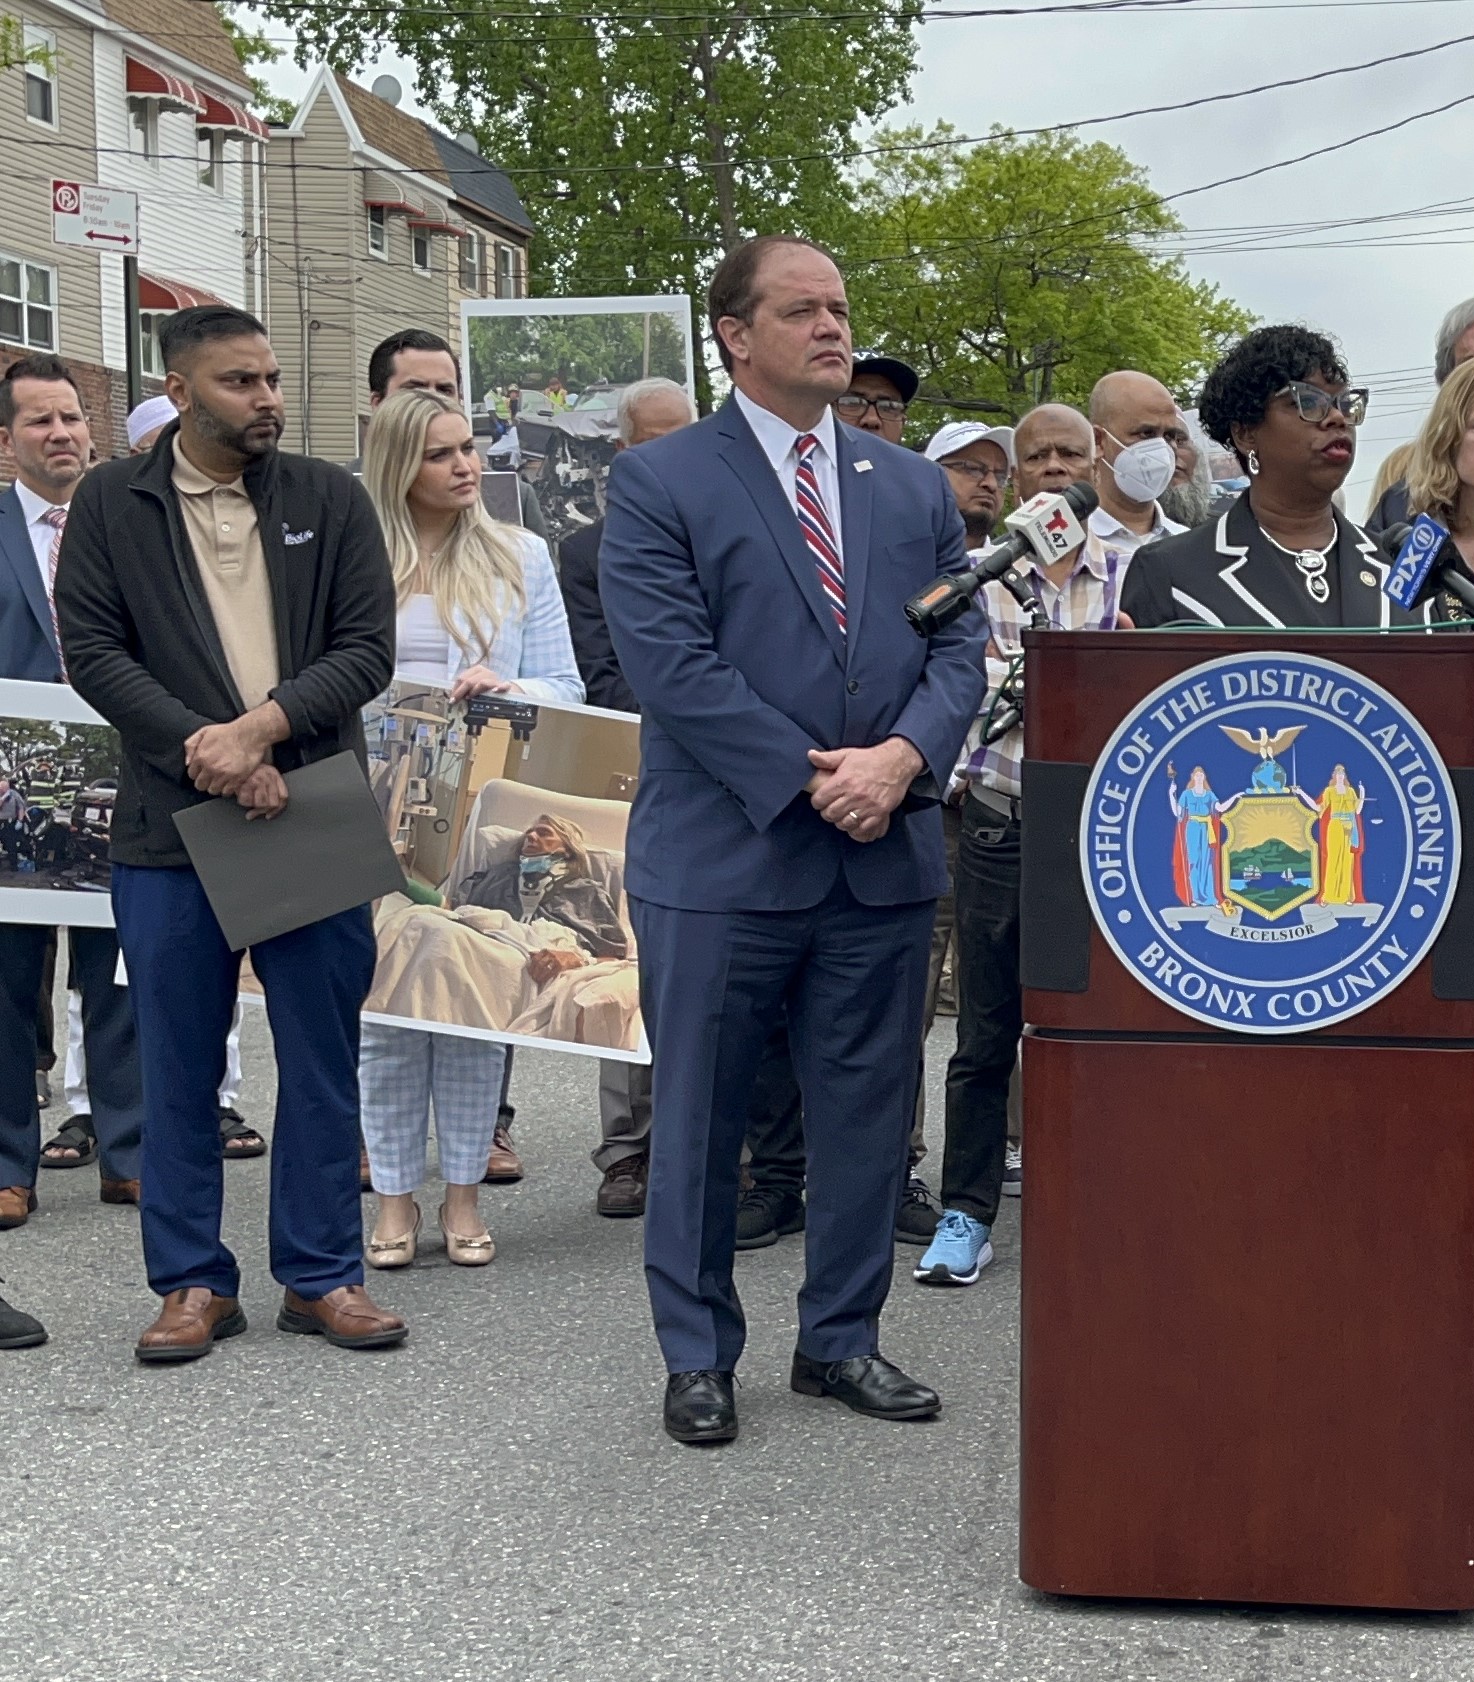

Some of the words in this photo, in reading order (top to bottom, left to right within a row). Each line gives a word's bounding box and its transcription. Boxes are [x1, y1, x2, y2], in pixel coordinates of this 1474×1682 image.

[83, 202, 104, 213] Friday
[1051, 532, 1068, 549] 47
[1095, 780, 1130, 899] OFFICE
[1117, 727, 1156, 775] OF
[1150, 681, 1217, 733] THE
[1221, 668, 1379, 723] DISTRICT
[1370, 722, 1446, 898] ATTORNEY
[1229, 924, 1317, 942] EXCELSIOR
[1137, 941, 1257, 1020] BRONX
[1267, 933, 1410, 1021] COUNTY
